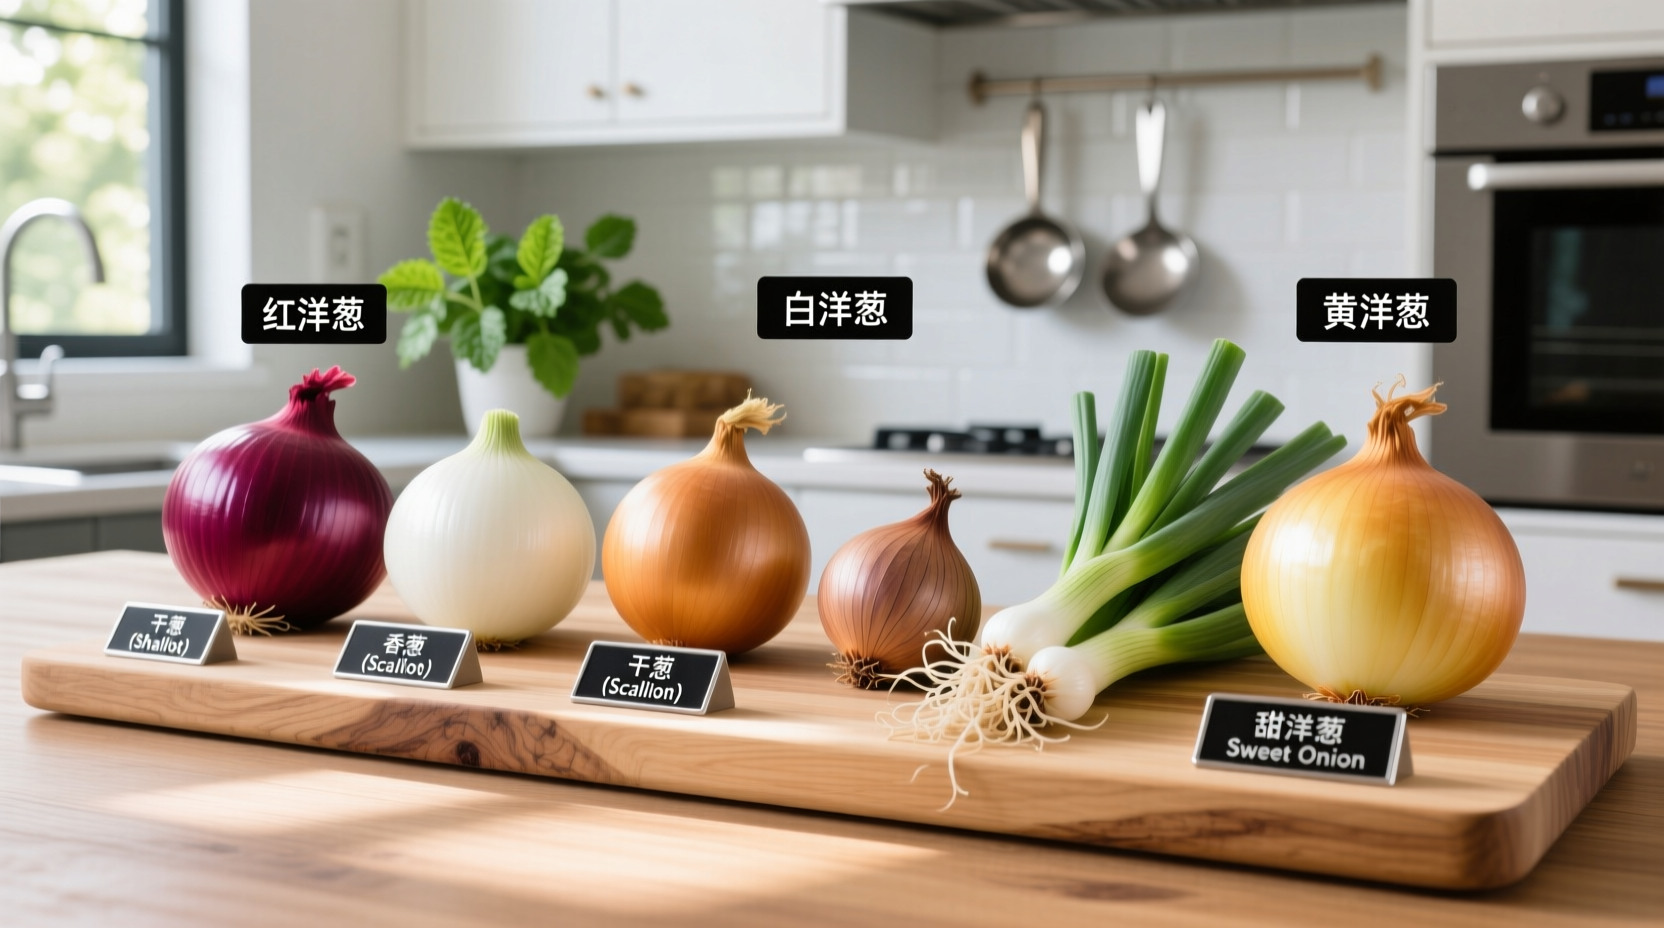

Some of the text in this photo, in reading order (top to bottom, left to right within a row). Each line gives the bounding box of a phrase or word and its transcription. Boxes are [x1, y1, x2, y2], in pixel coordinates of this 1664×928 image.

[628, 654, 675, 680] 干葱
[1254, 710, 1346, 745] 甜洋葱
[1226, 737, 1366, 770] Sweet Onion
